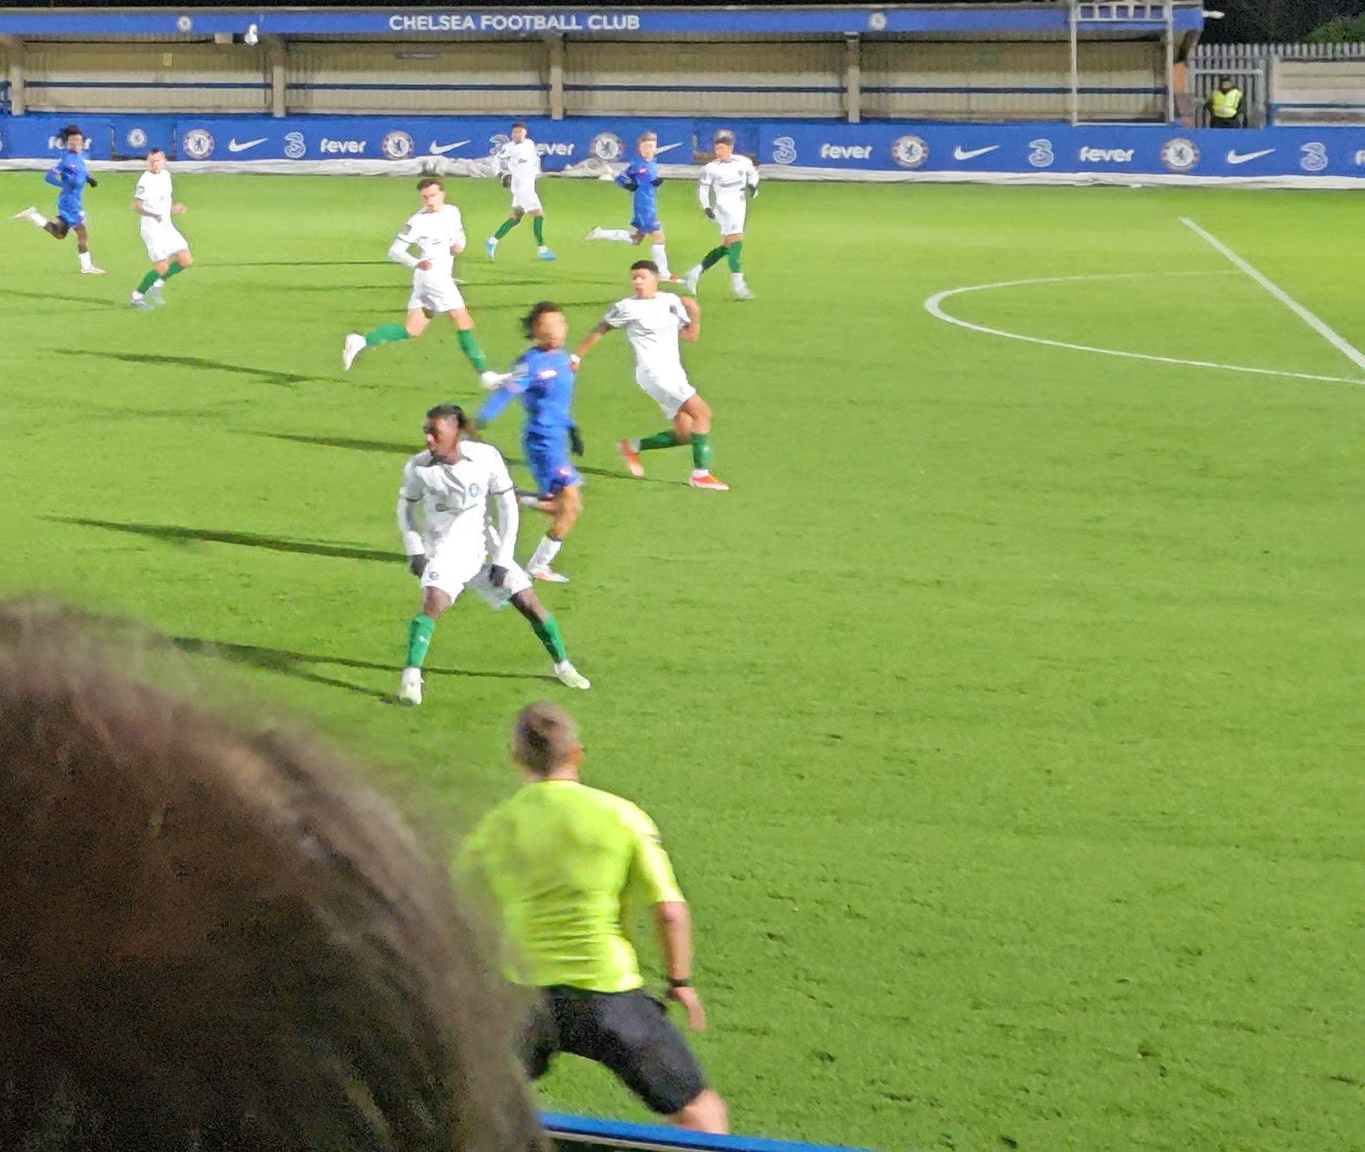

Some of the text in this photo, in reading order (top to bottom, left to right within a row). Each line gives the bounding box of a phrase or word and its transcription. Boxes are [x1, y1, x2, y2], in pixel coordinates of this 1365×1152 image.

[389, 15, 640, 30] CHELSEA FOOTBALL CLUB
[321, 138, 367, 154] fever
[821, 143, 873, 159] fever
[1080, 146, 1135, 163] fever
